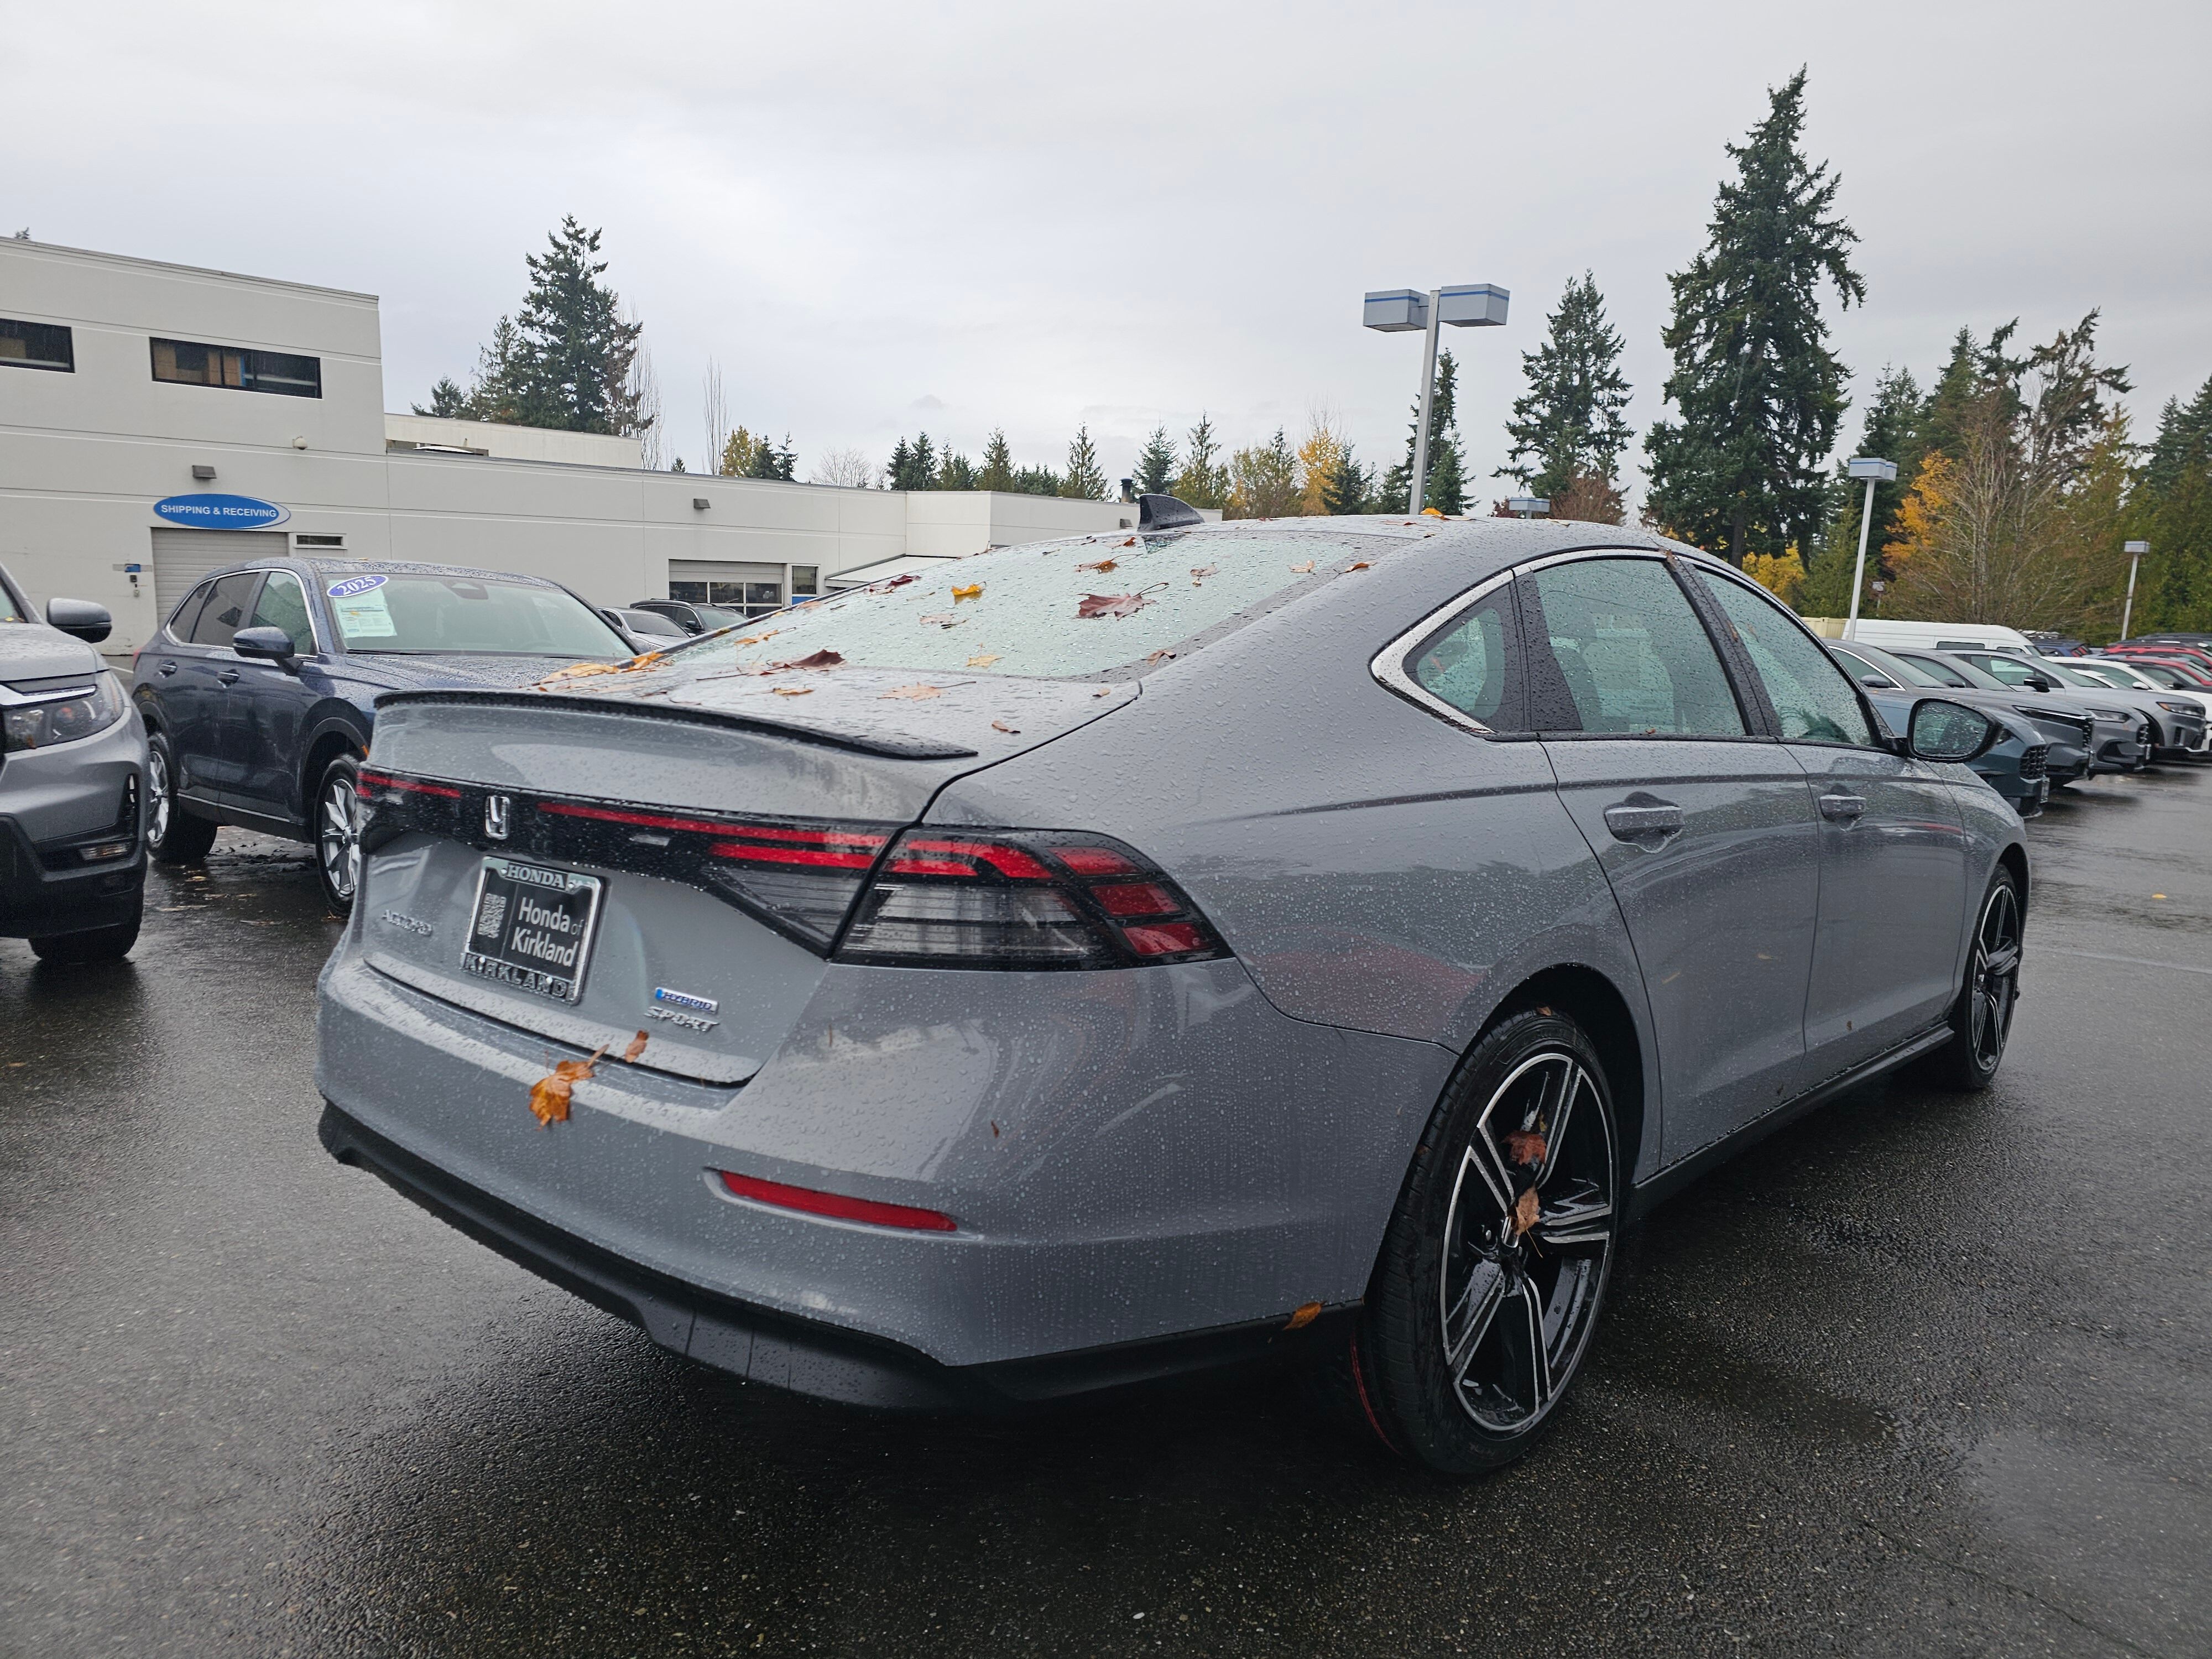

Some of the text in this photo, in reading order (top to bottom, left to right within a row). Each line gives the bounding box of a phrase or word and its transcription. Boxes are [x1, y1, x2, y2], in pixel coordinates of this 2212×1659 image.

[161, 504, 277, 518] SHIPPING & RECEIVING
[337, 576, 377, 596] 2025
[507, 864, 566, 889] HONDA
[518, 896, 585, 936] Honda of
[510, 926, 579, 967] Kirkland
[464, 953, 568, 998] KIRKLAND
[643, 1005, 719, 1032] SPORT
